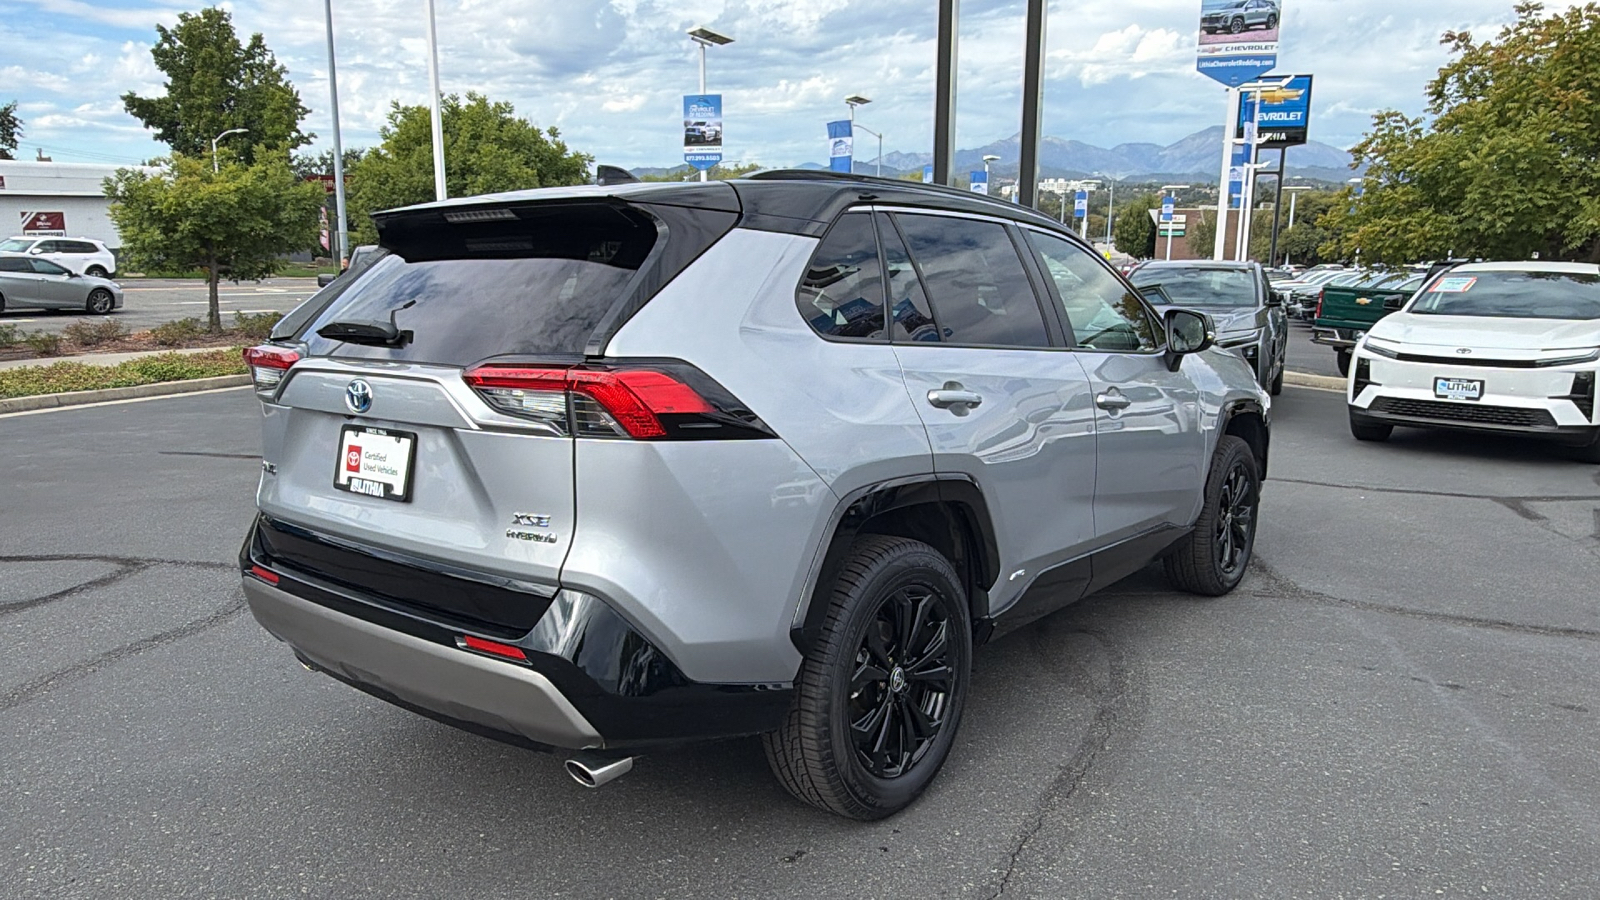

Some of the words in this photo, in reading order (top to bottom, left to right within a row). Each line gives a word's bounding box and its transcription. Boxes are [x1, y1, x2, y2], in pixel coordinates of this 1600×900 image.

[1243, 112, 1302, 121] EVROLET
[1447, 383, 1478, 392] LITHIA
[364, 451, 387, 462] Certified
[363, 462, 376, 473] Used
[377, 464, 398, 476] Vehicles
[511, 512, 551, 528] XSE
